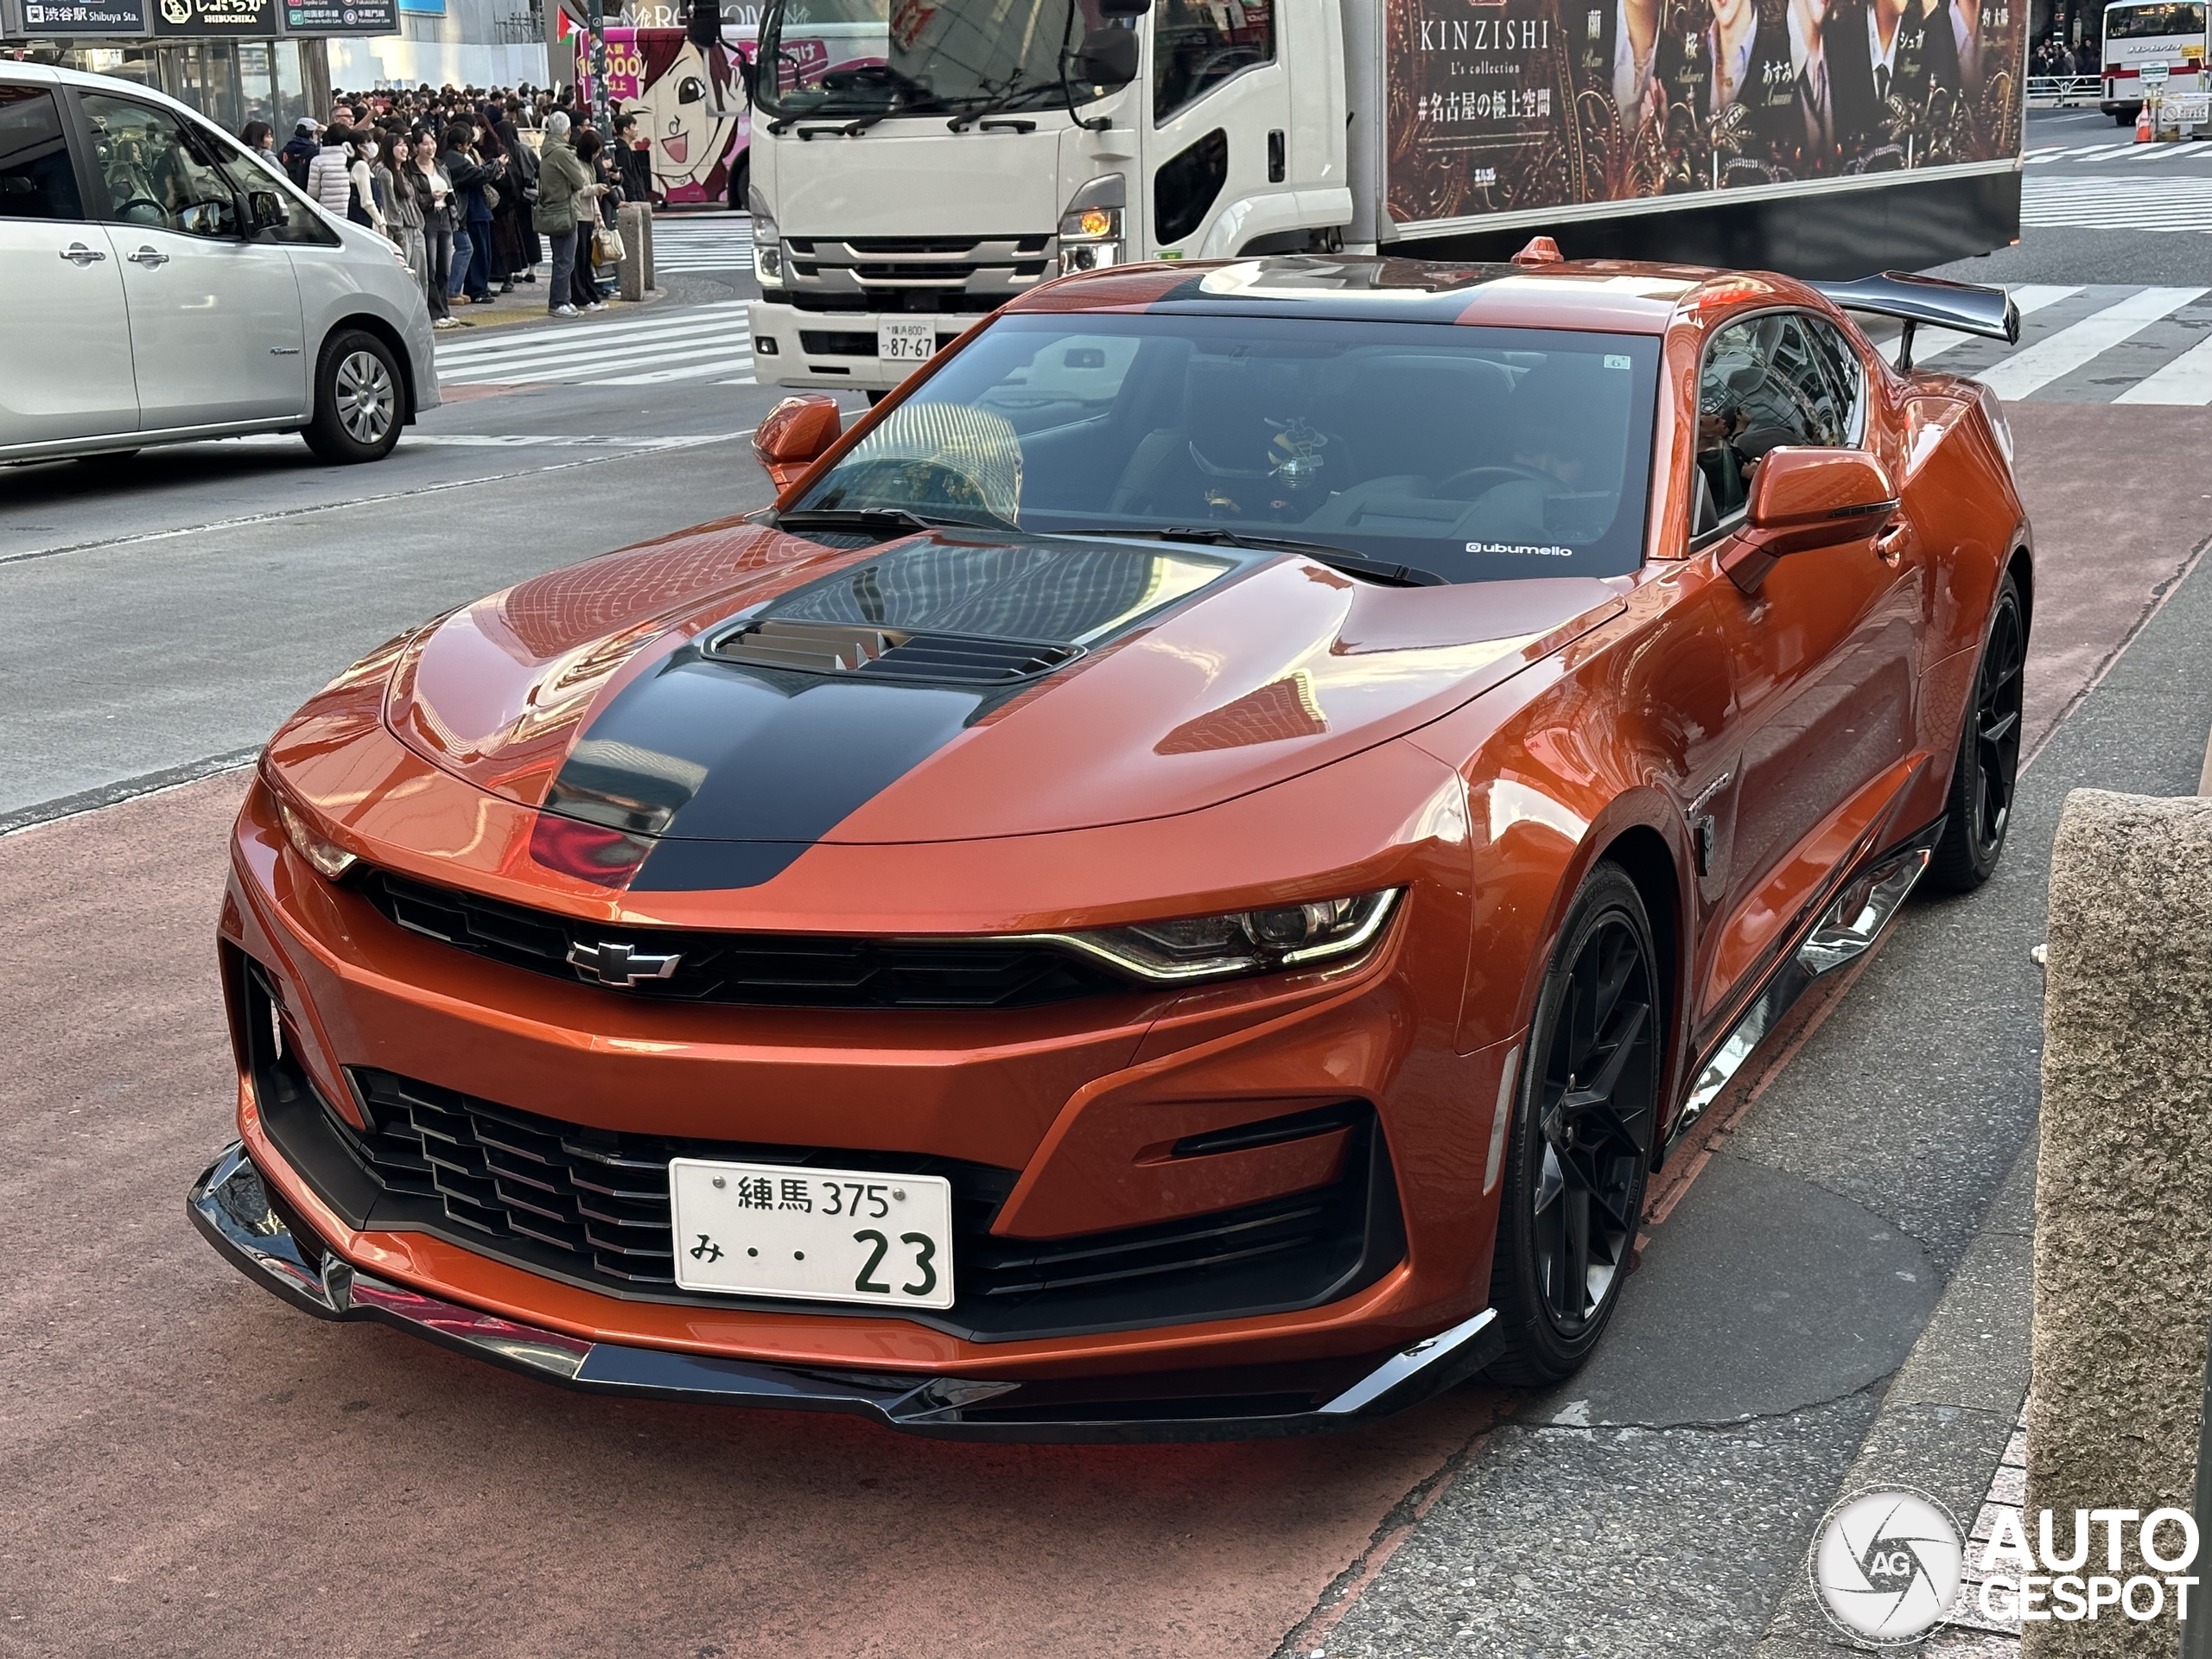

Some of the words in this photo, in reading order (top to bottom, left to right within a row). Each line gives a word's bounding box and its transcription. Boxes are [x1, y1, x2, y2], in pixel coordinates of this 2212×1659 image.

[45, 7, 88, 22] 渋谷駅
[89, 11, 121, 23] Shibuya
[123, 11, 139, 22] Sta.
[204, 15, 257, 23] SHIBUCHIKA
[1420, 19, 1549, 50] KINZISHI
[1451, 62, 1465, 75] L's
[1470, 60, 1520, 74] collection
[1418, 87, 1551, 122] #名古屋の極上空間
[908, 326, 923, 335] 800
[891, 338, 931, 357] 87-67
[1483, 543, 1573, 556] ubumello
[738, 1176, 812, 1213] 練馬
[822, 1181, 889, 1218] 375
[690, 1234, 724, 1263] み
[853, 1229, 937, 1296] 23
